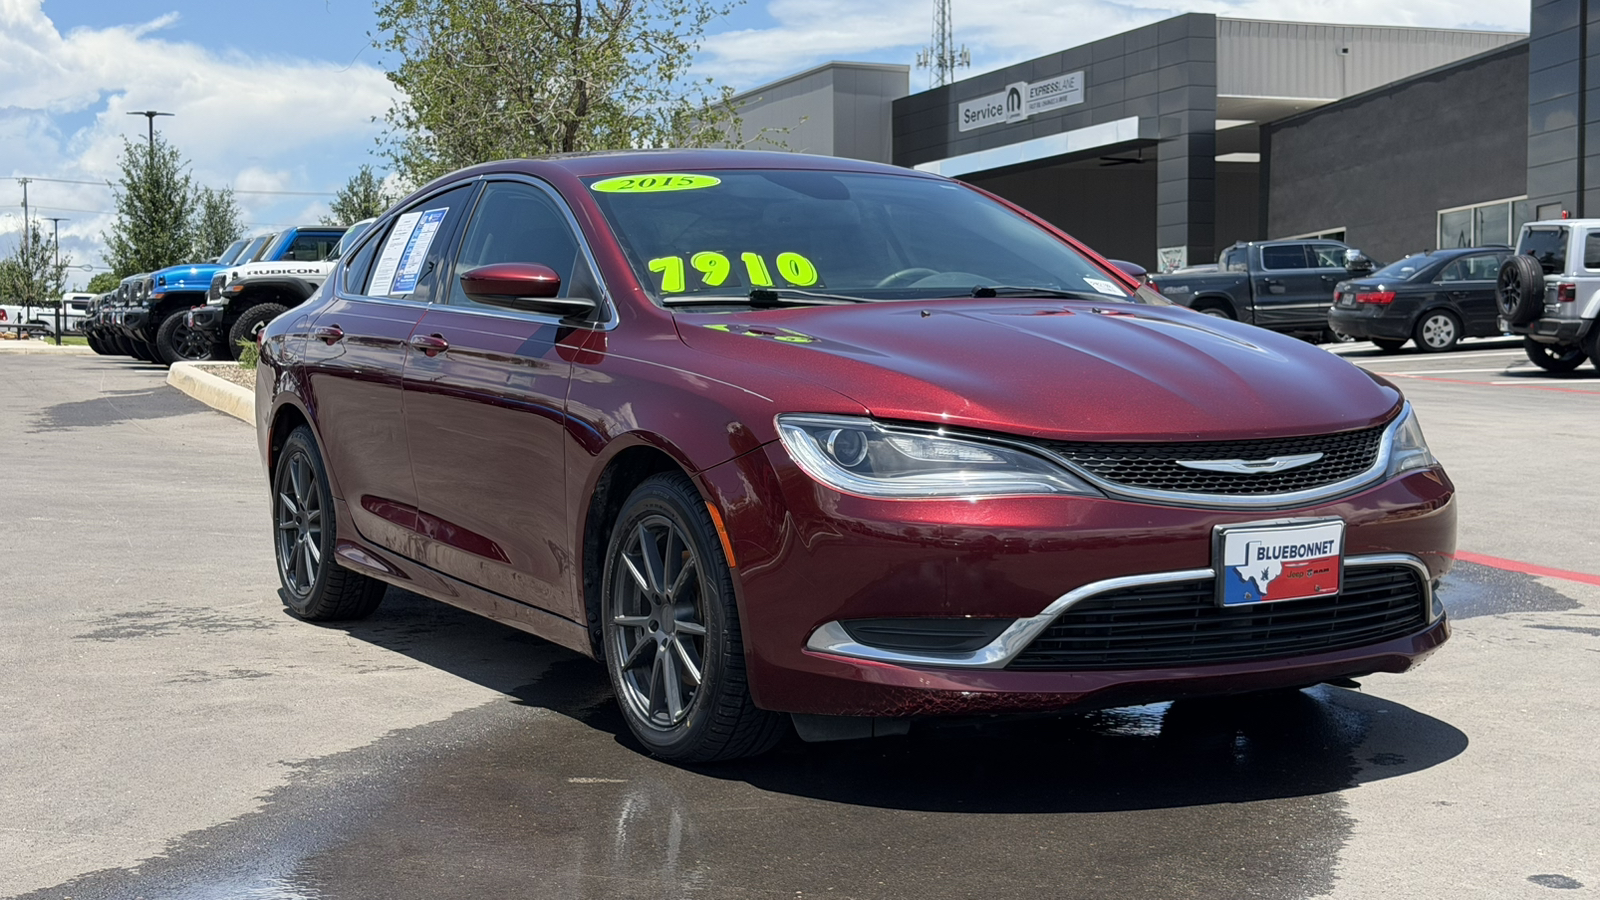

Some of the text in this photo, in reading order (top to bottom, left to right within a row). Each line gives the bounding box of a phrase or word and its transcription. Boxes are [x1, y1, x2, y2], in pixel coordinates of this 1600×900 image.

[963, 103, 1003, 124] Service
[618, 176, 695, 190] 2015
[247, 268, 320, 276] RUBICON
[648, 251, 818, 293] 7910
[1256, 539, 1335, 561] BLUEBONNET
[1286, 570, 1304, 579] Jeep
